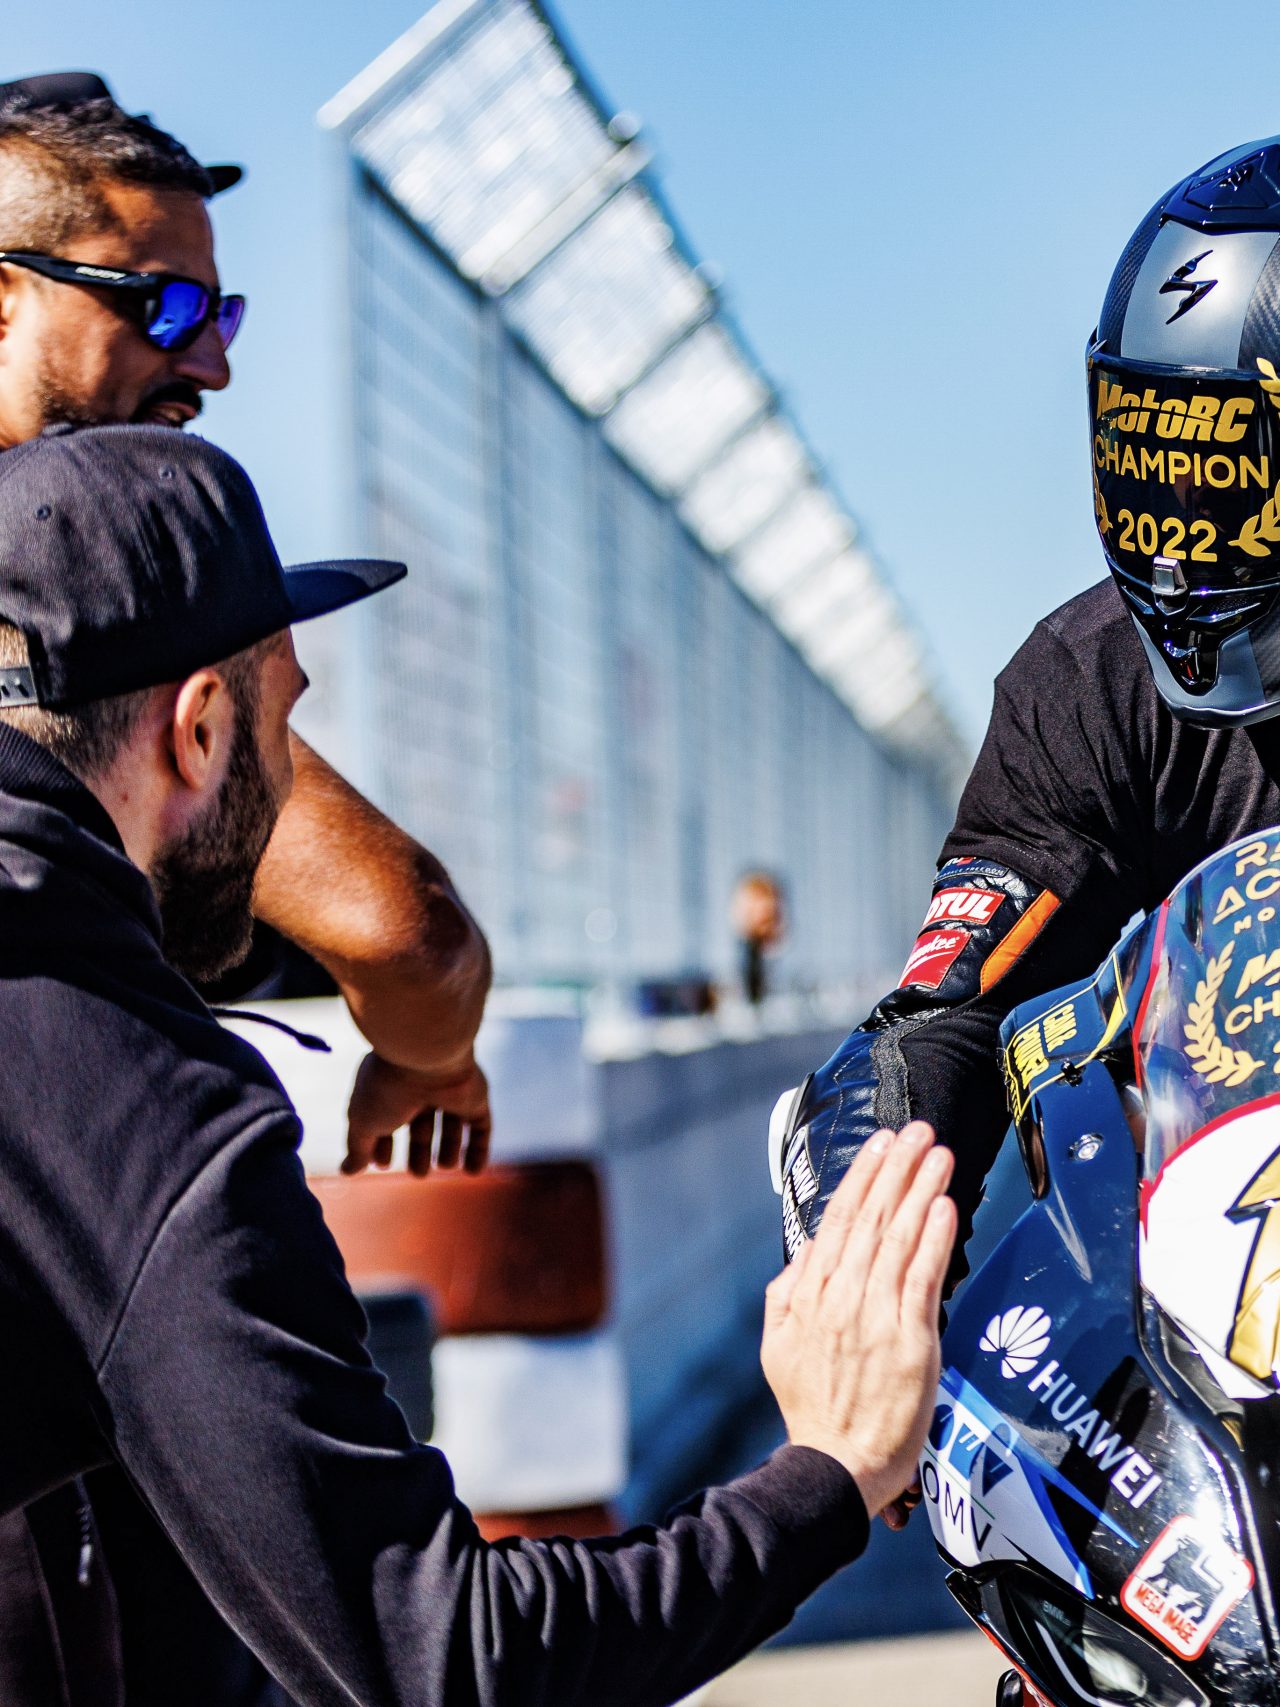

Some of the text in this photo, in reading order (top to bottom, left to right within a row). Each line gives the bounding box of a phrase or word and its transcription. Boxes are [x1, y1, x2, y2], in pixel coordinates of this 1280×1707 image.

[1093, 434, 1270, 489] CHAMPION
[1117, 508, 1218, 563] 2022
[1027, 1359, 1163, 1509] HUAWEI
[922, 1460, 993, 1553] OMV
[1134, 1583, 1198, 1645] MEGA IMAGE
